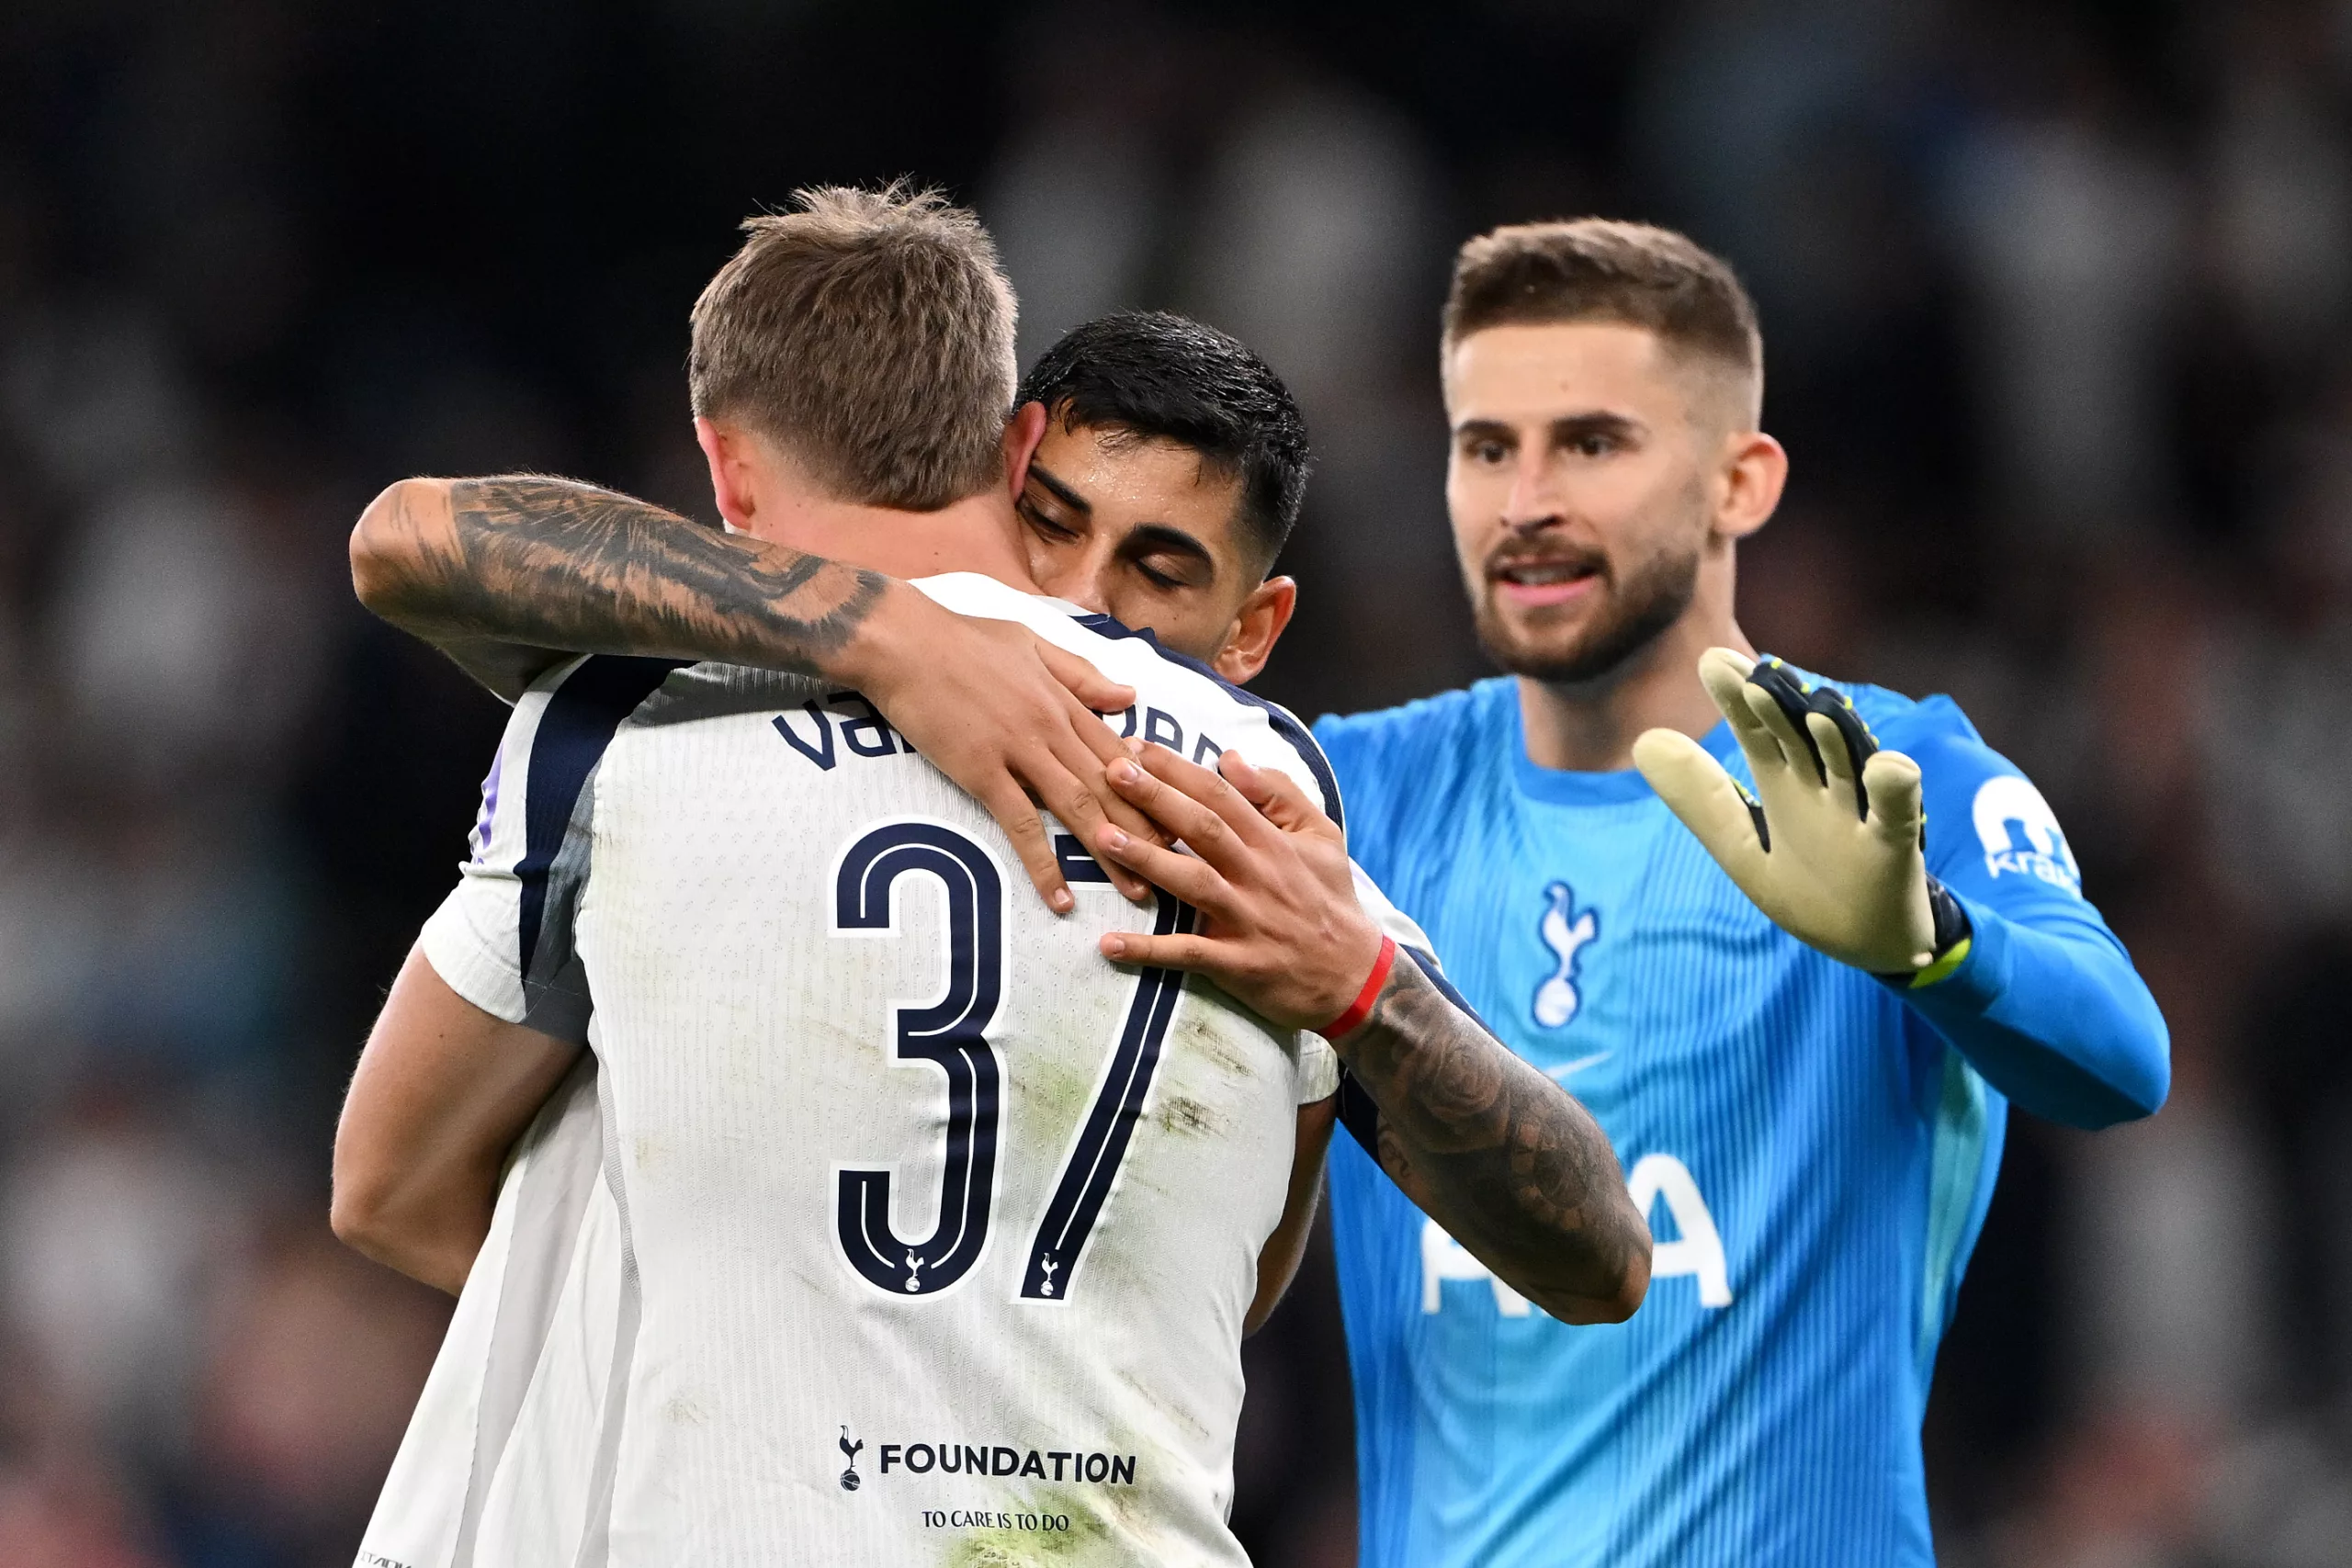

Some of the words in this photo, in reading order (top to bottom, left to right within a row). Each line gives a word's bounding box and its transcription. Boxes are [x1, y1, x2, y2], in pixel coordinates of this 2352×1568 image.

[835, 821, 1199, 1300] 37
[1421, 1153, 1733, 1317] AA
[880, 1443, 1136, 1484] FOUNDATION
[922, 1511, 946, 1528] TO
[951, 1510, 993, 1529] CARE
[998, 1513, 1012, 1529] IS
[1015, 1513, 1037, 1530] TO
[1042, 1515, 1069, 1532] DO
